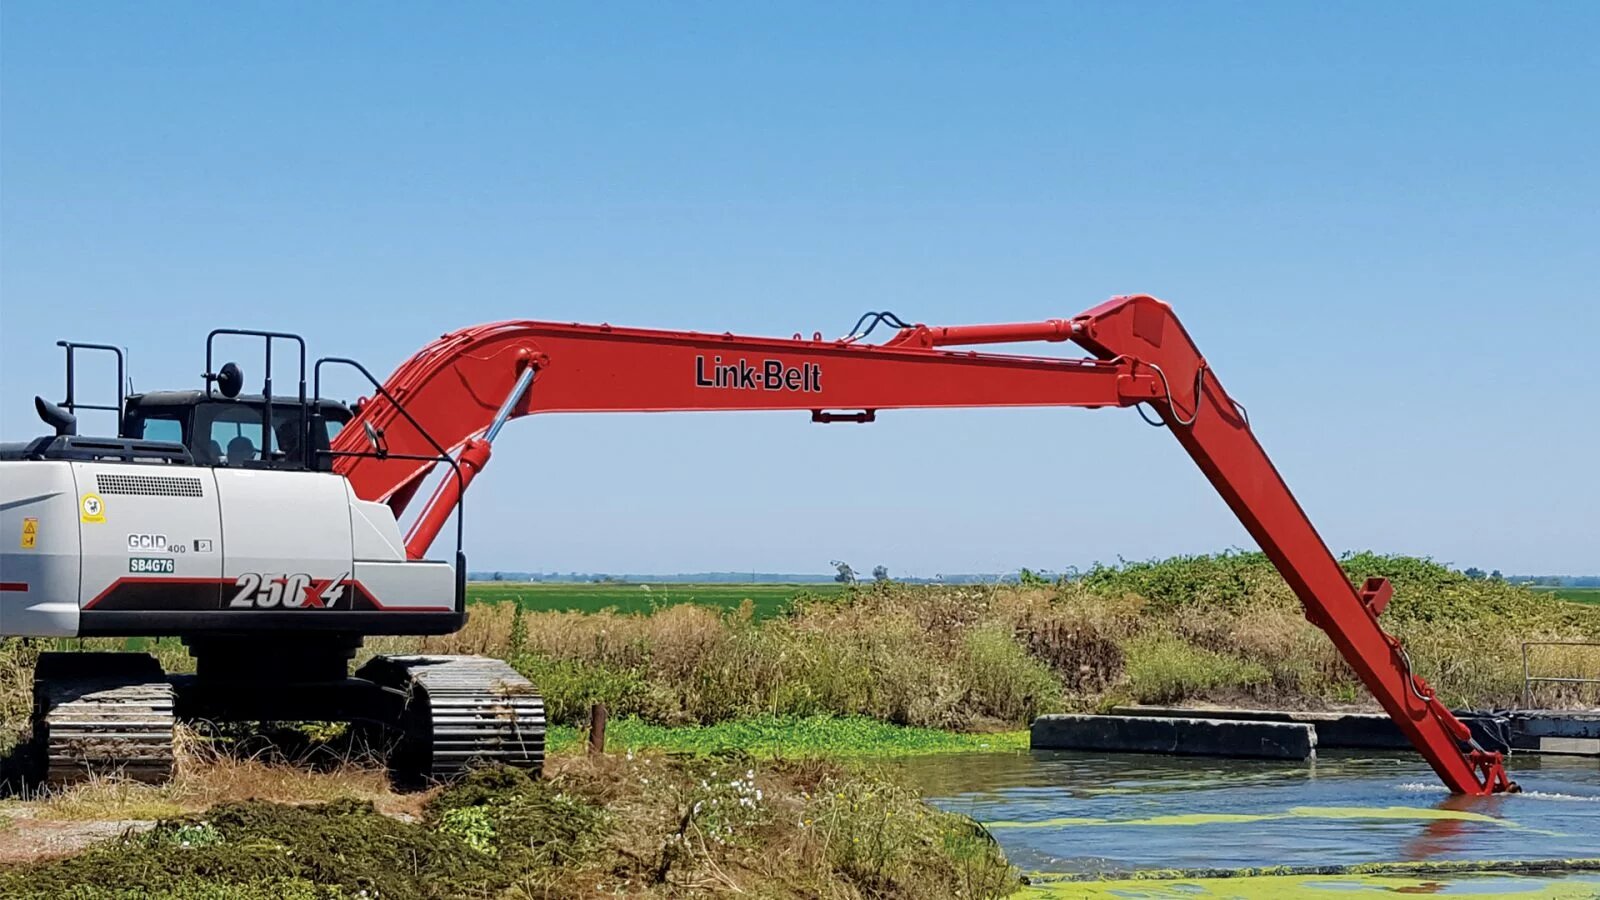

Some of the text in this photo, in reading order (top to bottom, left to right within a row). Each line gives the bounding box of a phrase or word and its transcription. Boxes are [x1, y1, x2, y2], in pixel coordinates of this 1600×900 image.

[128, 534, 186, 553] GCID 400
[131, 559, 173, 571] SB4G76
